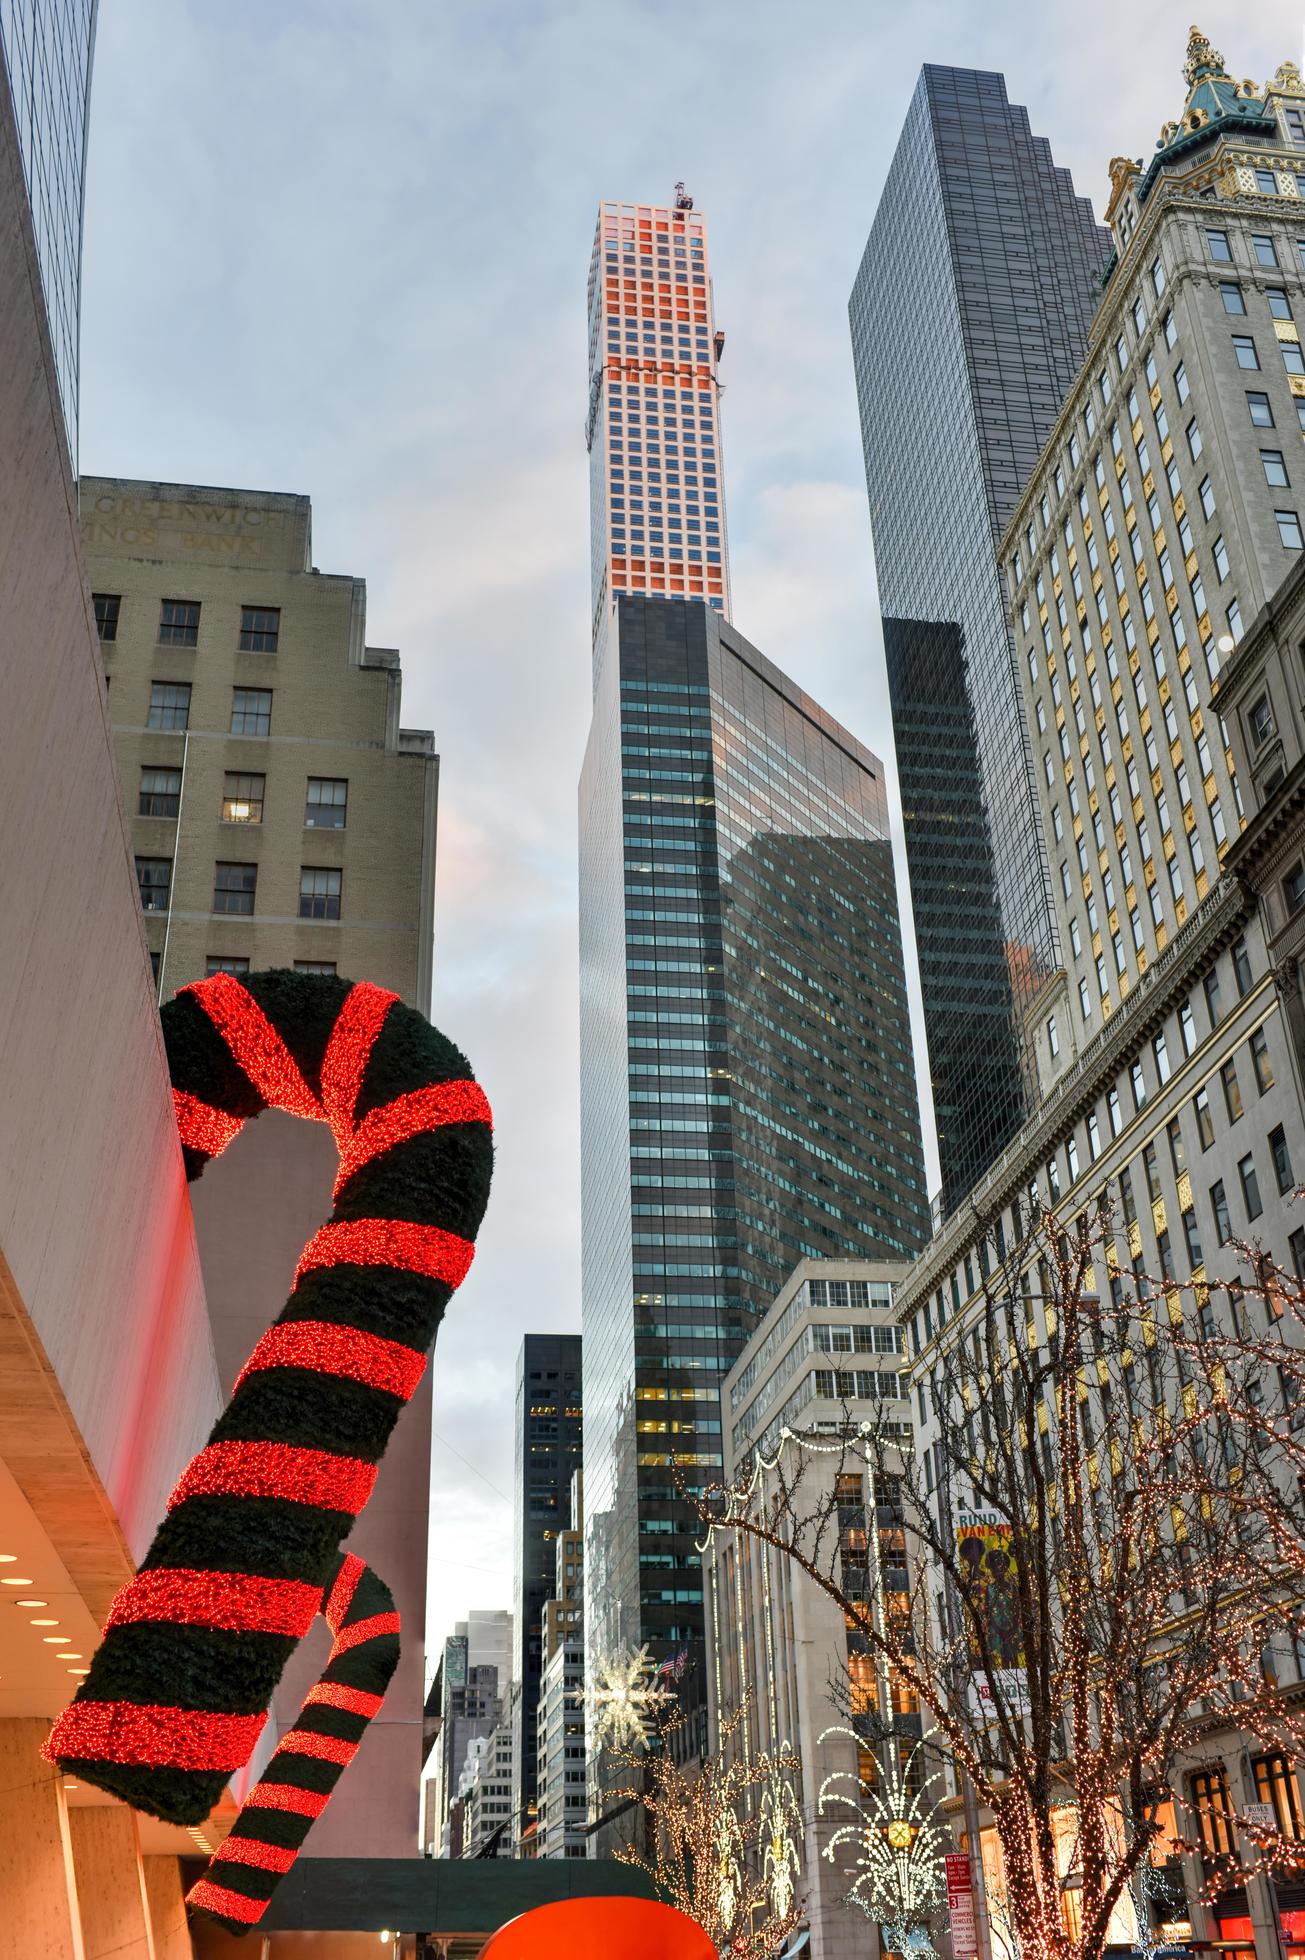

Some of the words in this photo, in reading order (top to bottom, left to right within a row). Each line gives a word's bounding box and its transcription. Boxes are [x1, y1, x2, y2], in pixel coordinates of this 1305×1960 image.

[94, 495, 285, 529] GREENWICH
[183, 531, 259, 554] BANK
[960, 1525, 985, 1538] VAN
[1248, 1805, 1268, 1813] BUSES
[946, 1856, 953, 1864] NO
[953, 1855, 969, 1863] STAND
[950, 1896, 957, 1909] 3
